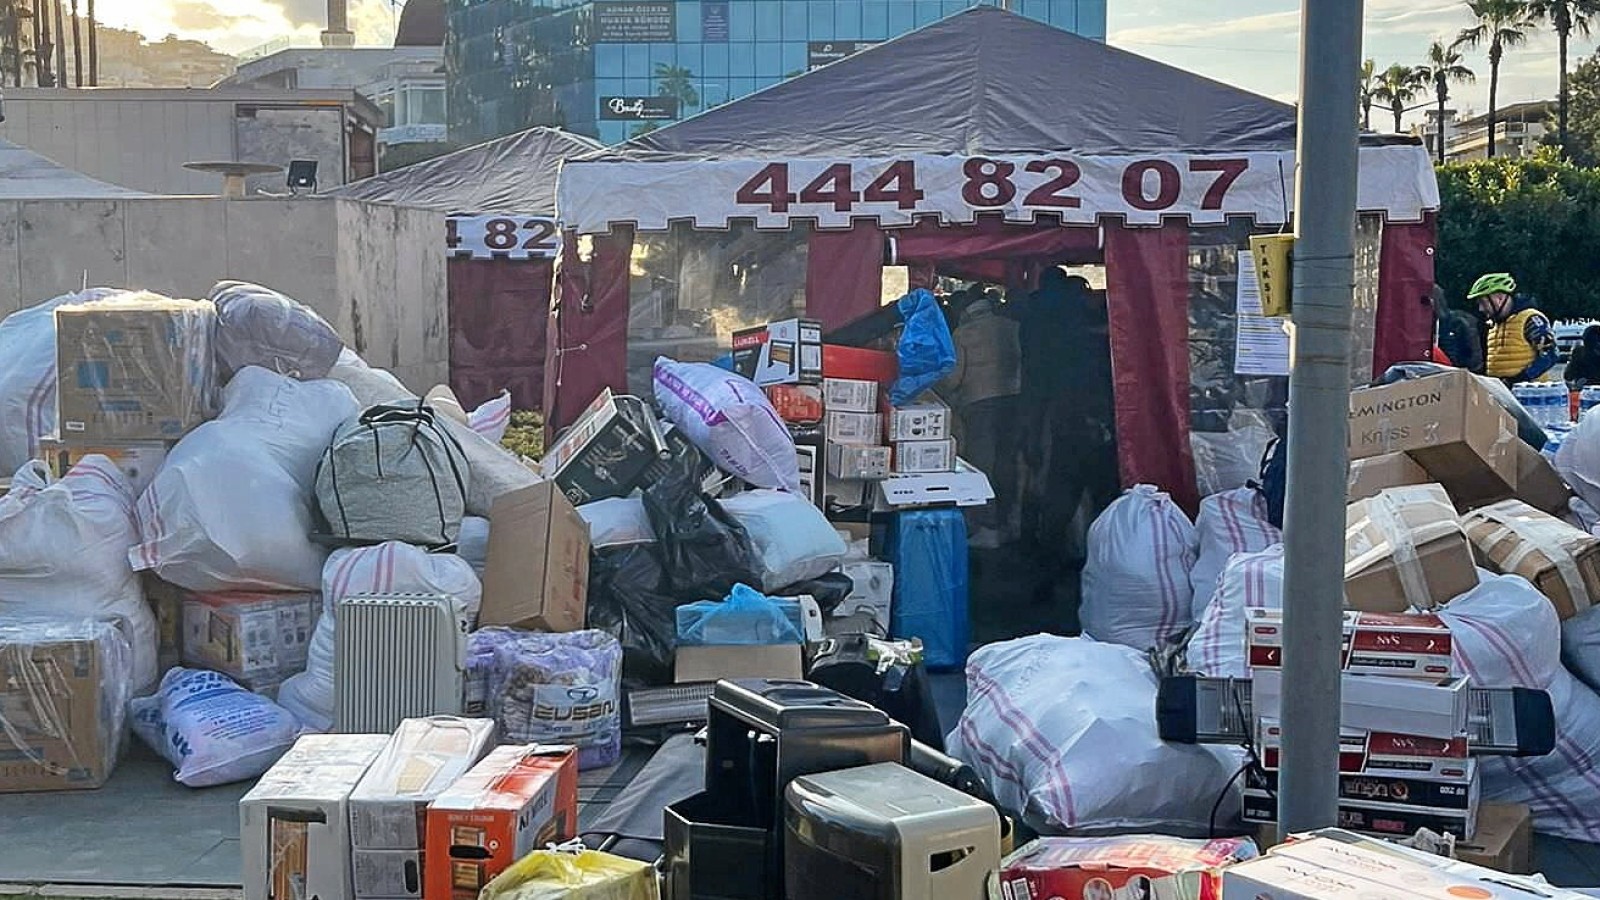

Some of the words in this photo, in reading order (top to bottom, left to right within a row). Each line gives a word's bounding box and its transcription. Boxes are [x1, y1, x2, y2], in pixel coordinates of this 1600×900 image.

[735, 159, 924, 213] 444
[961, 157, 1082, 208] 82
[1121, 158, 1249, 211] 07
[483, 218, 557, 249] 82
[1348, 391, 1441, 419] EMINGTON
